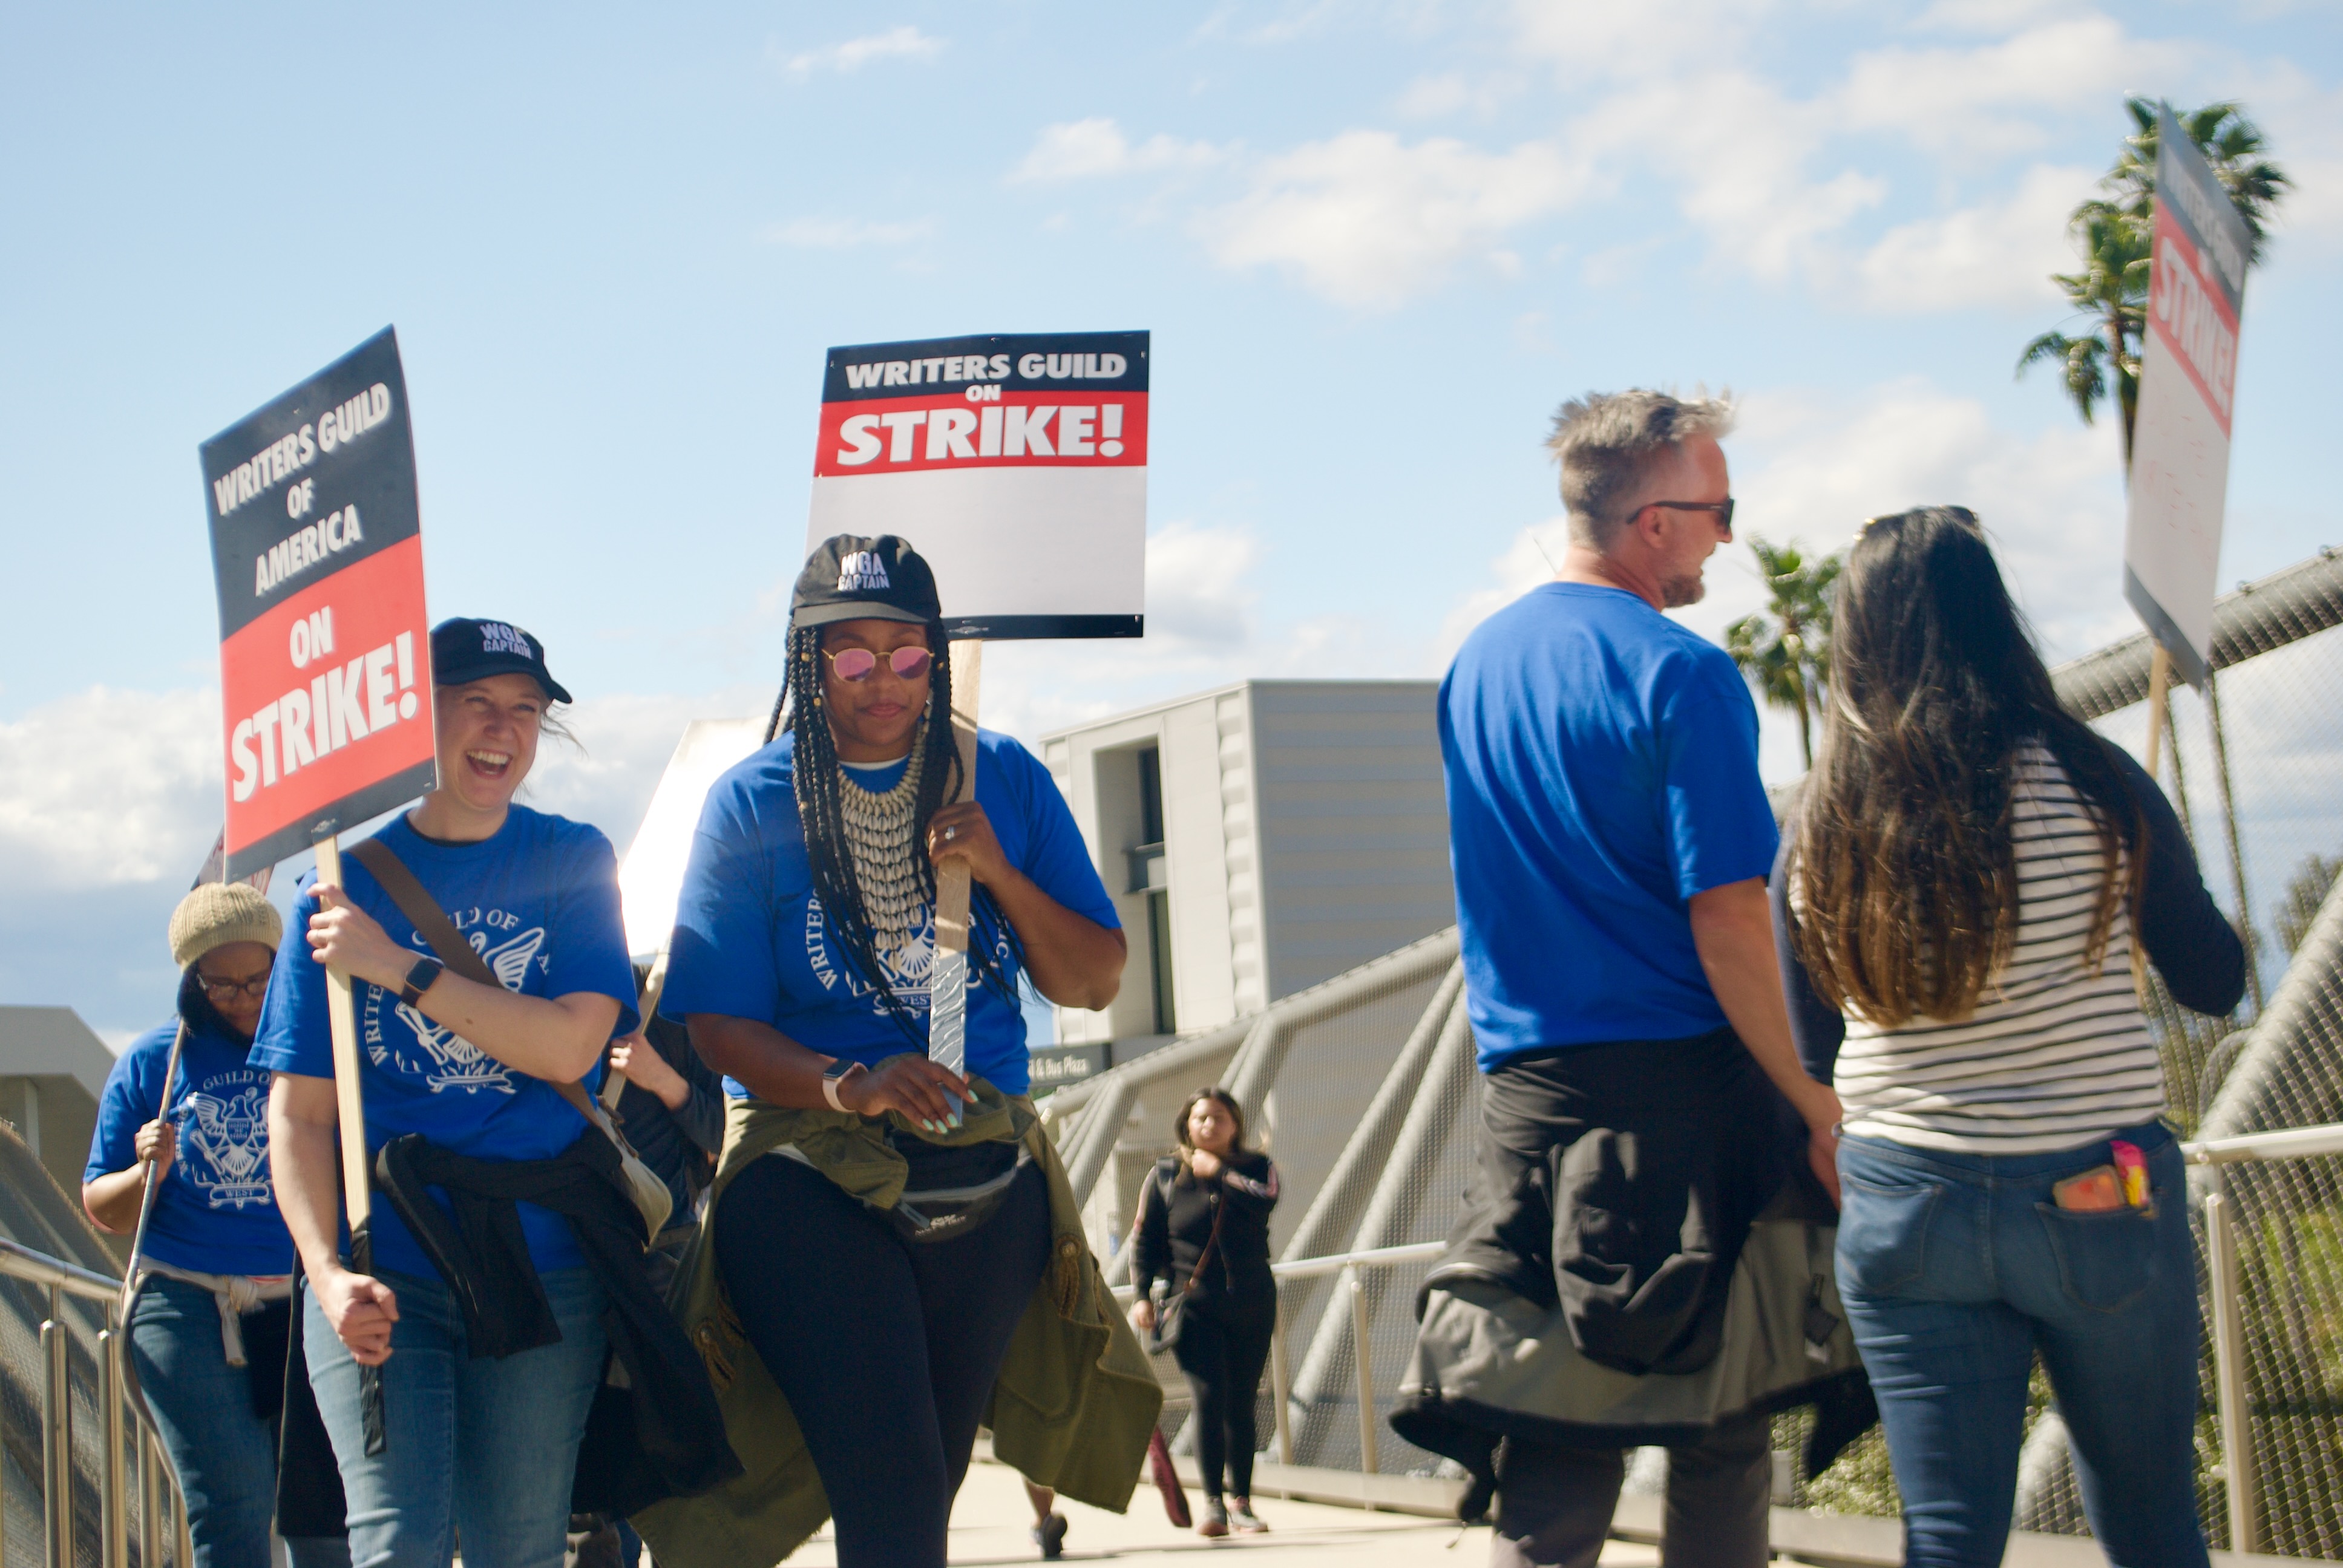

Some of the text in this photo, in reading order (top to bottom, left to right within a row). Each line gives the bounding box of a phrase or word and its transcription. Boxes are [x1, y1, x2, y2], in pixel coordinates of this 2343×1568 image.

[845, 353, 1127, 388] WRITERS GUILD
[965, 384, 1001, 402] ON
[214, 382, 392, 516] WRITERS GUILD
[836, 403, 1125, 466] STRIKE!
[286, 477, 315, 520] OF
[255, 503, 363, 598] AMERICA
[841, 550, 887, 575] WGA
[837, 574, 891, 591] CAPTAIN
[290, 606, 333, 669] ON
[479, 622, 528, 647] WGA
[483, 639, 532, 660] CAPTAIN
[231, 630, 418, 803] STRIKE!
[487, 909, 519, 930] OF
[805, 889, 838, 991] WRITER
[364, 984, 388, 1068] WRITE
[203, 1070, 270, 1092] GUILD O
[1046, 1058, 1063, 1079] Bus
[1064, 1054, 1089, 1076] Plaza
[225, 1189, 254, 1198] WEST
